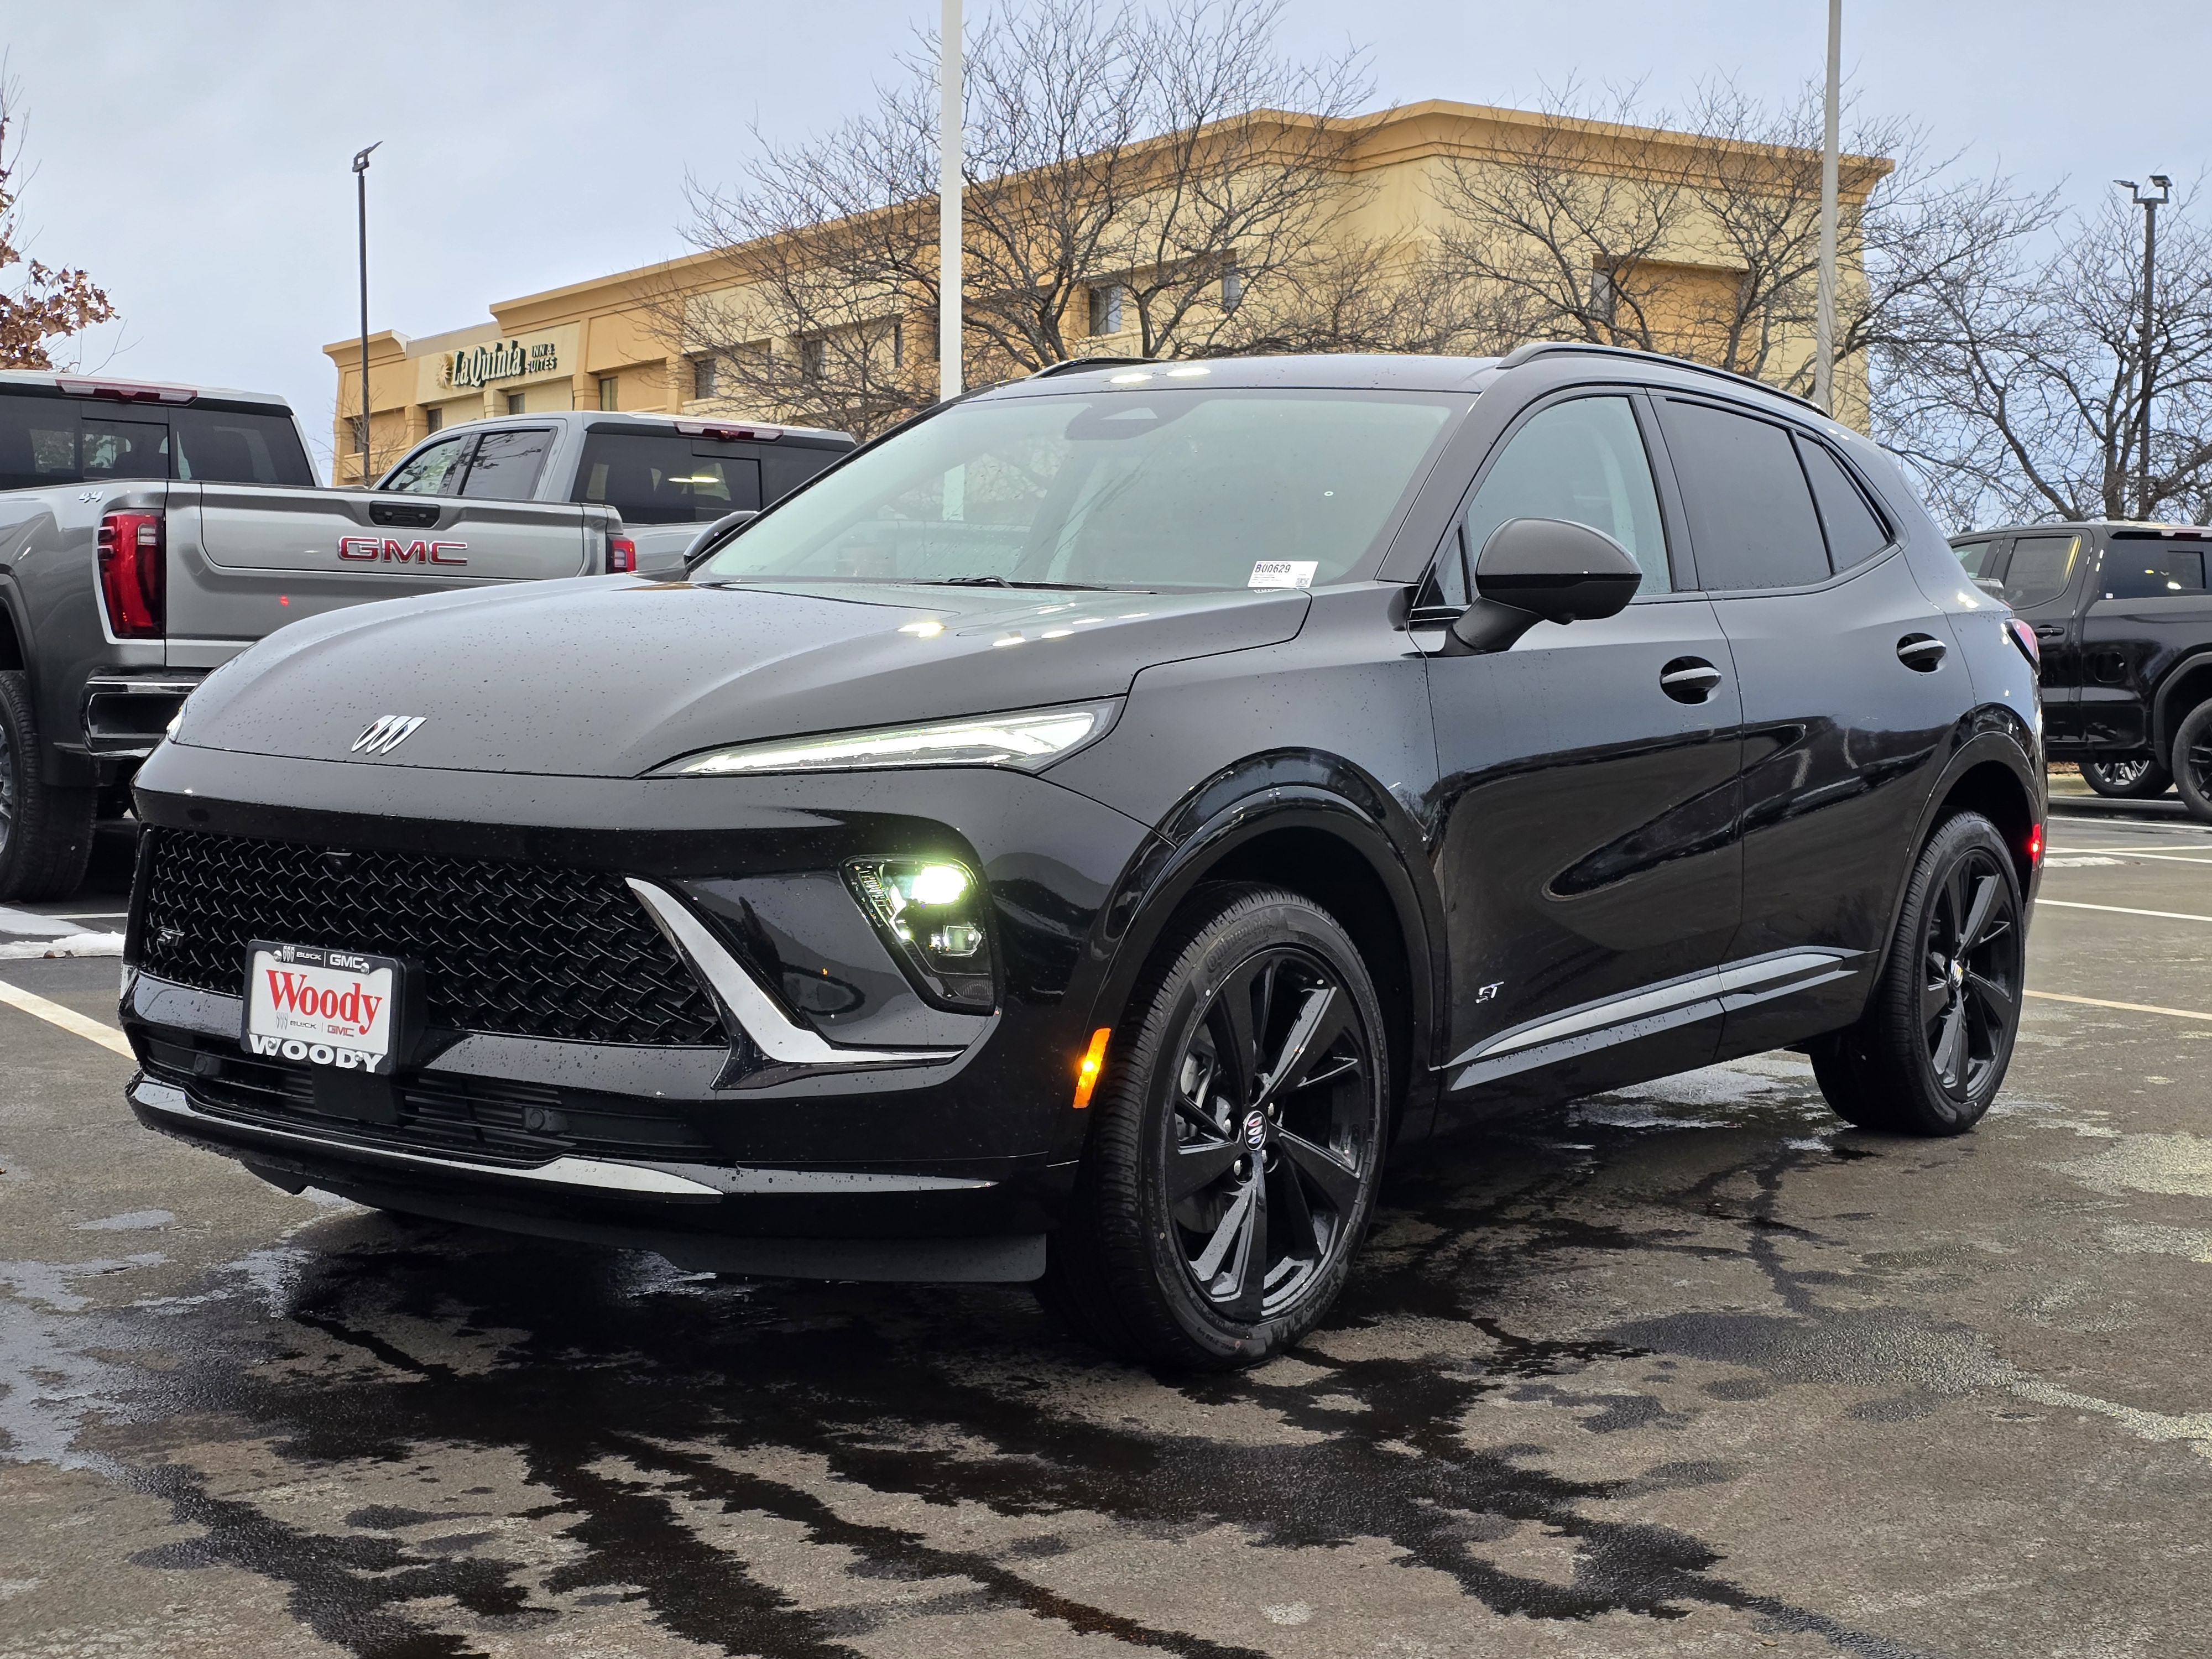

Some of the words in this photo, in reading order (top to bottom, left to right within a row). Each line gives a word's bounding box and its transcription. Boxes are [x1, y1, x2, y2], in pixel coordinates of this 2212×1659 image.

[530, 343, 547, 357] INN
[546, 343, 555, 355] &
[525, 357, 557, 373] SUITES
[338, 536, 468, 566] GMC
[1255, 564, 1291, 573] B00629
[330, 953, 364, 969] GMC
[1475, 981, 1505, 1004] ST
[266, 969, 383, 1035] Woody
[290, 1020, 317, 1029] BUICK
[327, 1024, 355, 1037] GMC
[249, 1034, 385, 1073] WOODY
